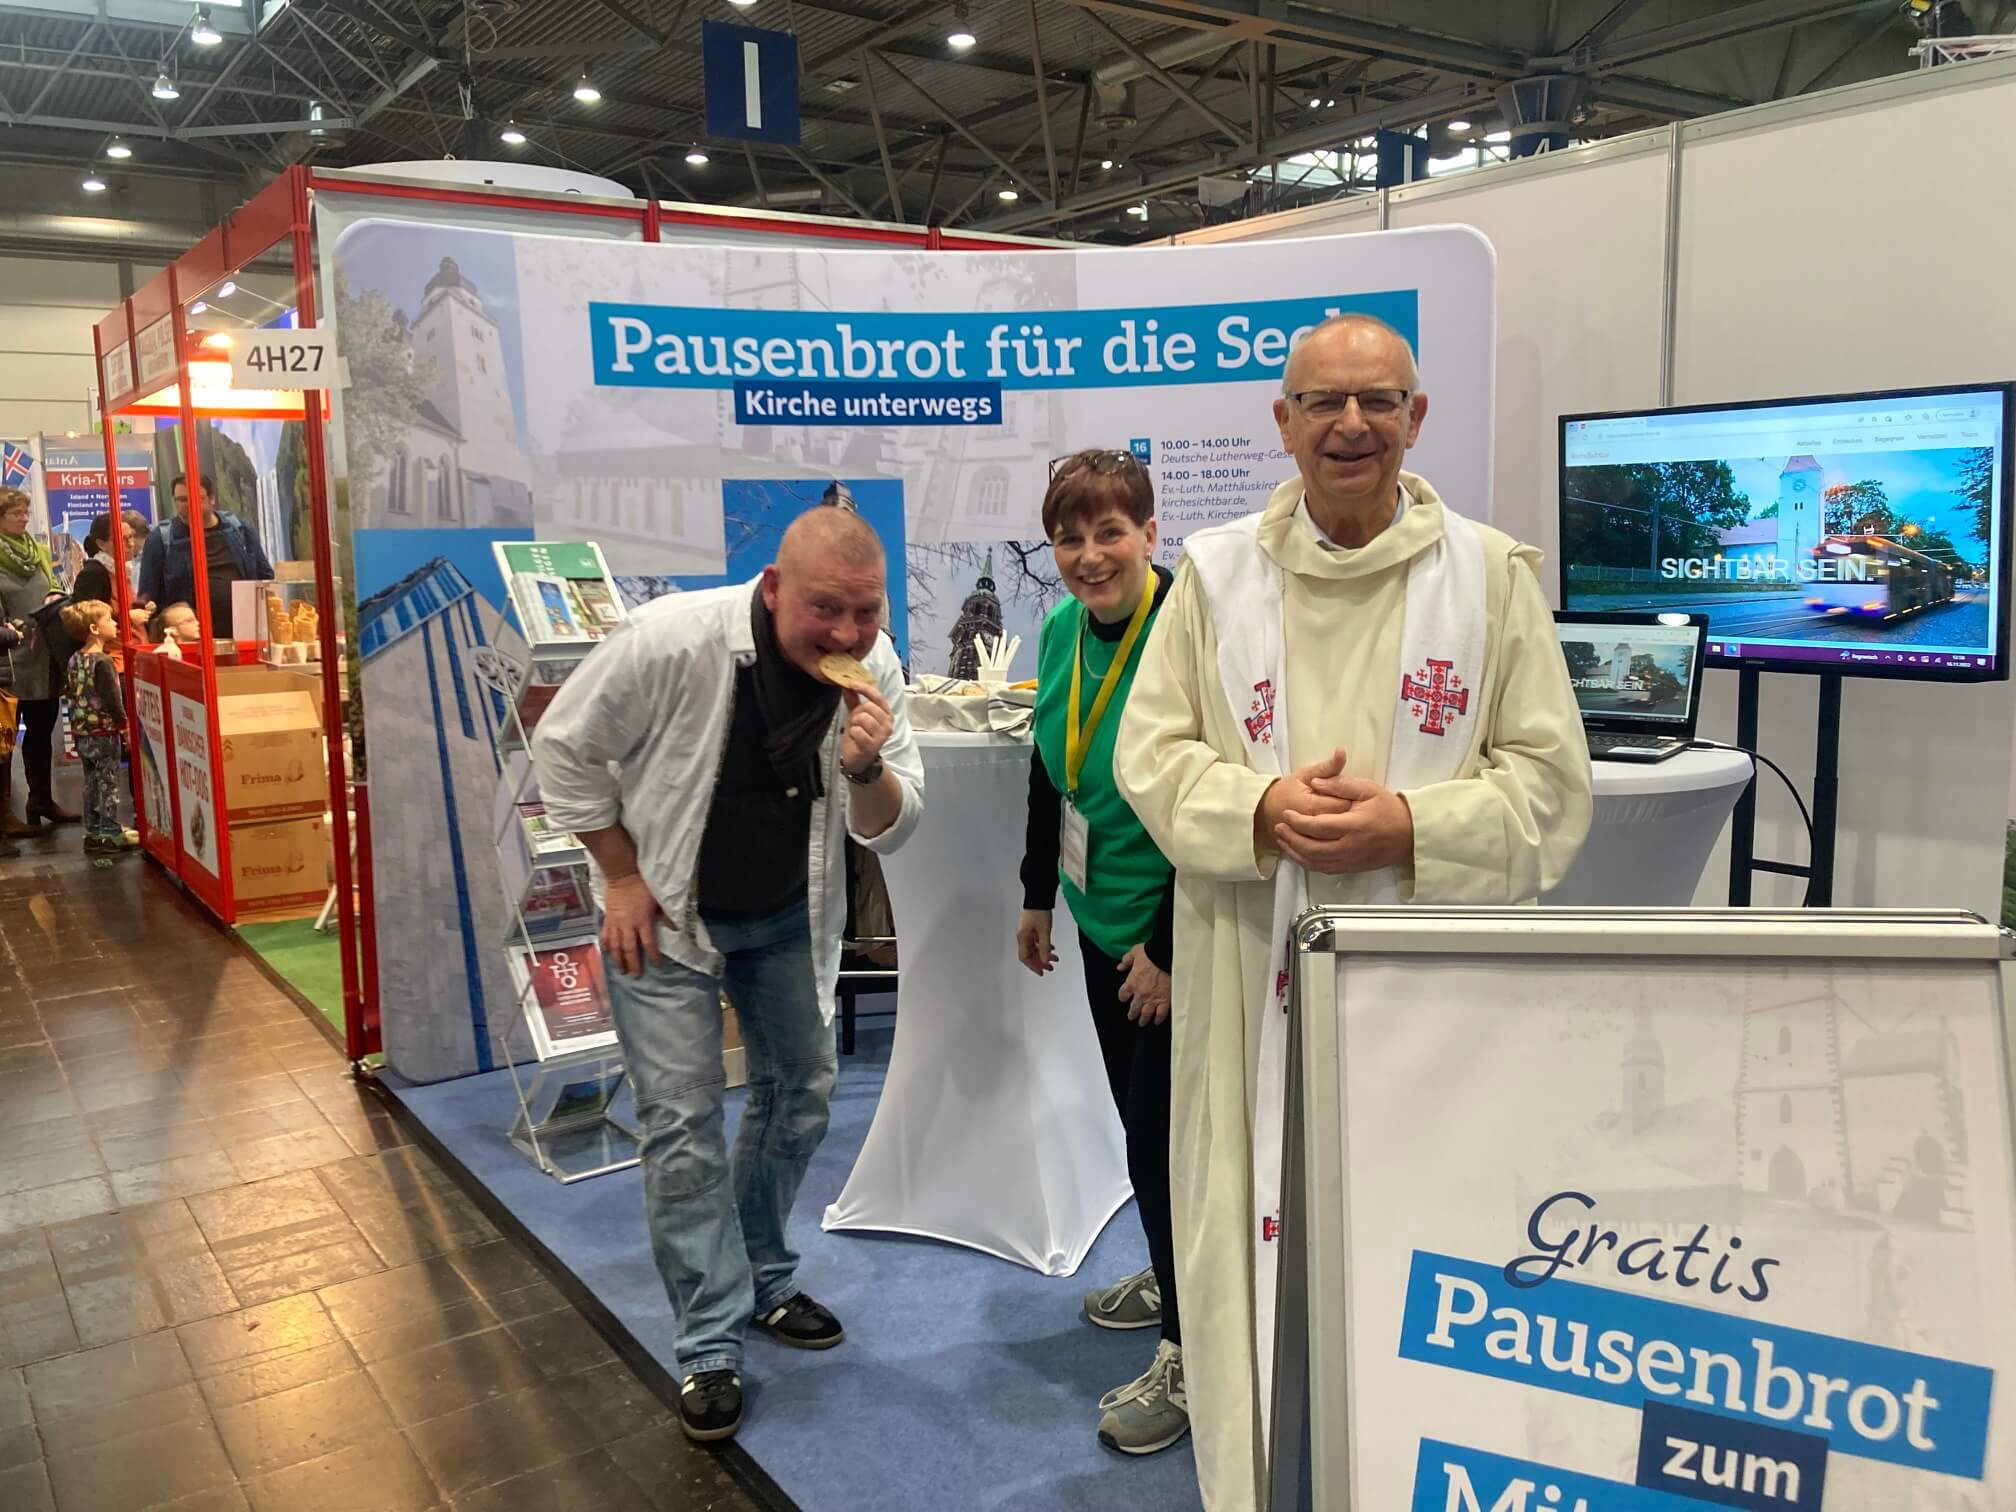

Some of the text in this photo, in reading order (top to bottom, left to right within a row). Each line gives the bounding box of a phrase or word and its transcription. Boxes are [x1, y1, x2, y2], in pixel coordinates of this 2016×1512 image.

[608, 308, 1341, 379] Pausenbrot für die Se
[246, 345, 323, 372] 4H27
[745, 389, 992, 422] Kirche unterwegs
[1134, 442, 1147, 453] 16
[1161, 440, 1190, 450] 10.00
[1201, 438, 1229, 448] 14.00
[1231, 437, 1251, 447] Uhr
[1161, 453, 1209, 464] Deutsche
[1210, 449, 1294, 461] Lutherweg-Ges
[1161, 470, 1190, 480] 14.00
[1201, 469, 1229, 479] 18.00
[1231, 468, 1251, 478] Uhr
[1161, 480, 1281, 495] Ev.-Luth. Matthäuskirch
[1162, 496, 1248, 508] kirchesichtbar.de,
[1162, 509, 1249, 521] Ev.-Luth. Kirchen
[1162, 537, 1184, 547] 10.0
[1162, 551, 1179, 561] Ev.-
[1661, 557, 1875, 582] SICHTBAR SEIN.
[1571, 678, 1614, 690] CHTBAR
[240, 772, 281, 785] Frima
[241, 865, 282, 877] Frima
[1503, 1191, 1780, 1302] Gratis
[1425, 1272, 1939, 1452] Pausenbrot
[1662, 1437, 1800, 1502] zum
